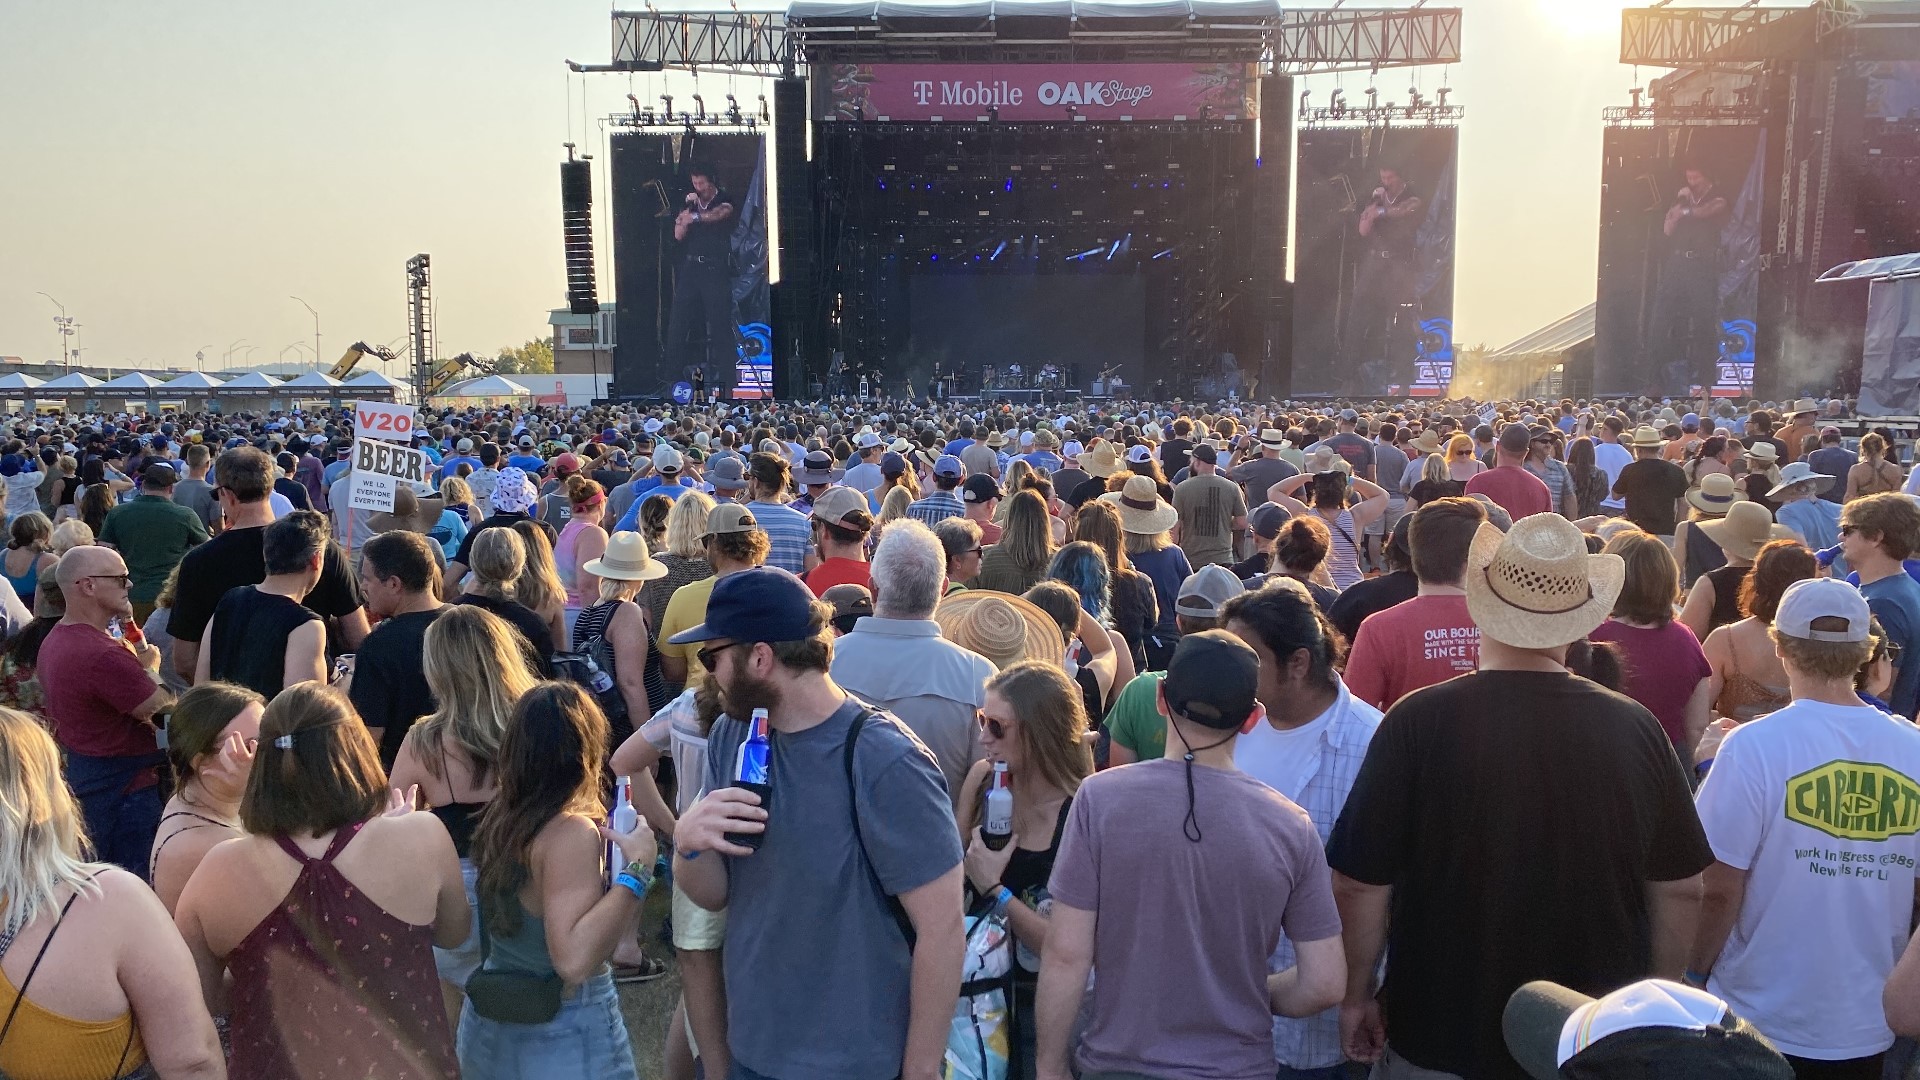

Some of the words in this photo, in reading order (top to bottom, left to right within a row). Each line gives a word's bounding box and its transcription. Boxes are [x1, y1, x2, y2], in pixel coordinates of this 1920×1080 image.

[913, 81, 933, 105] T
[940, 80, 1023, 106] Mobile
[1037, 81, 1106, 105] OAK
[1099, 79, 1153, 107] Stage
[358, 410, 411, 433] V20
[357, 441, 422, 482] BEER
[355, 497, 376, 505] EVERY
[357, 488, 391, 498] EVERYONE
[1425, 629, 1448, 640] OUR
[1425, 646, 1466, 659] SINCE
[1794, 846, 1821, 860] Work
[1825, 849, 1837, 862] In
[1809, 861, 1838, 877] New
[1855, 866, 1874, 878] For
